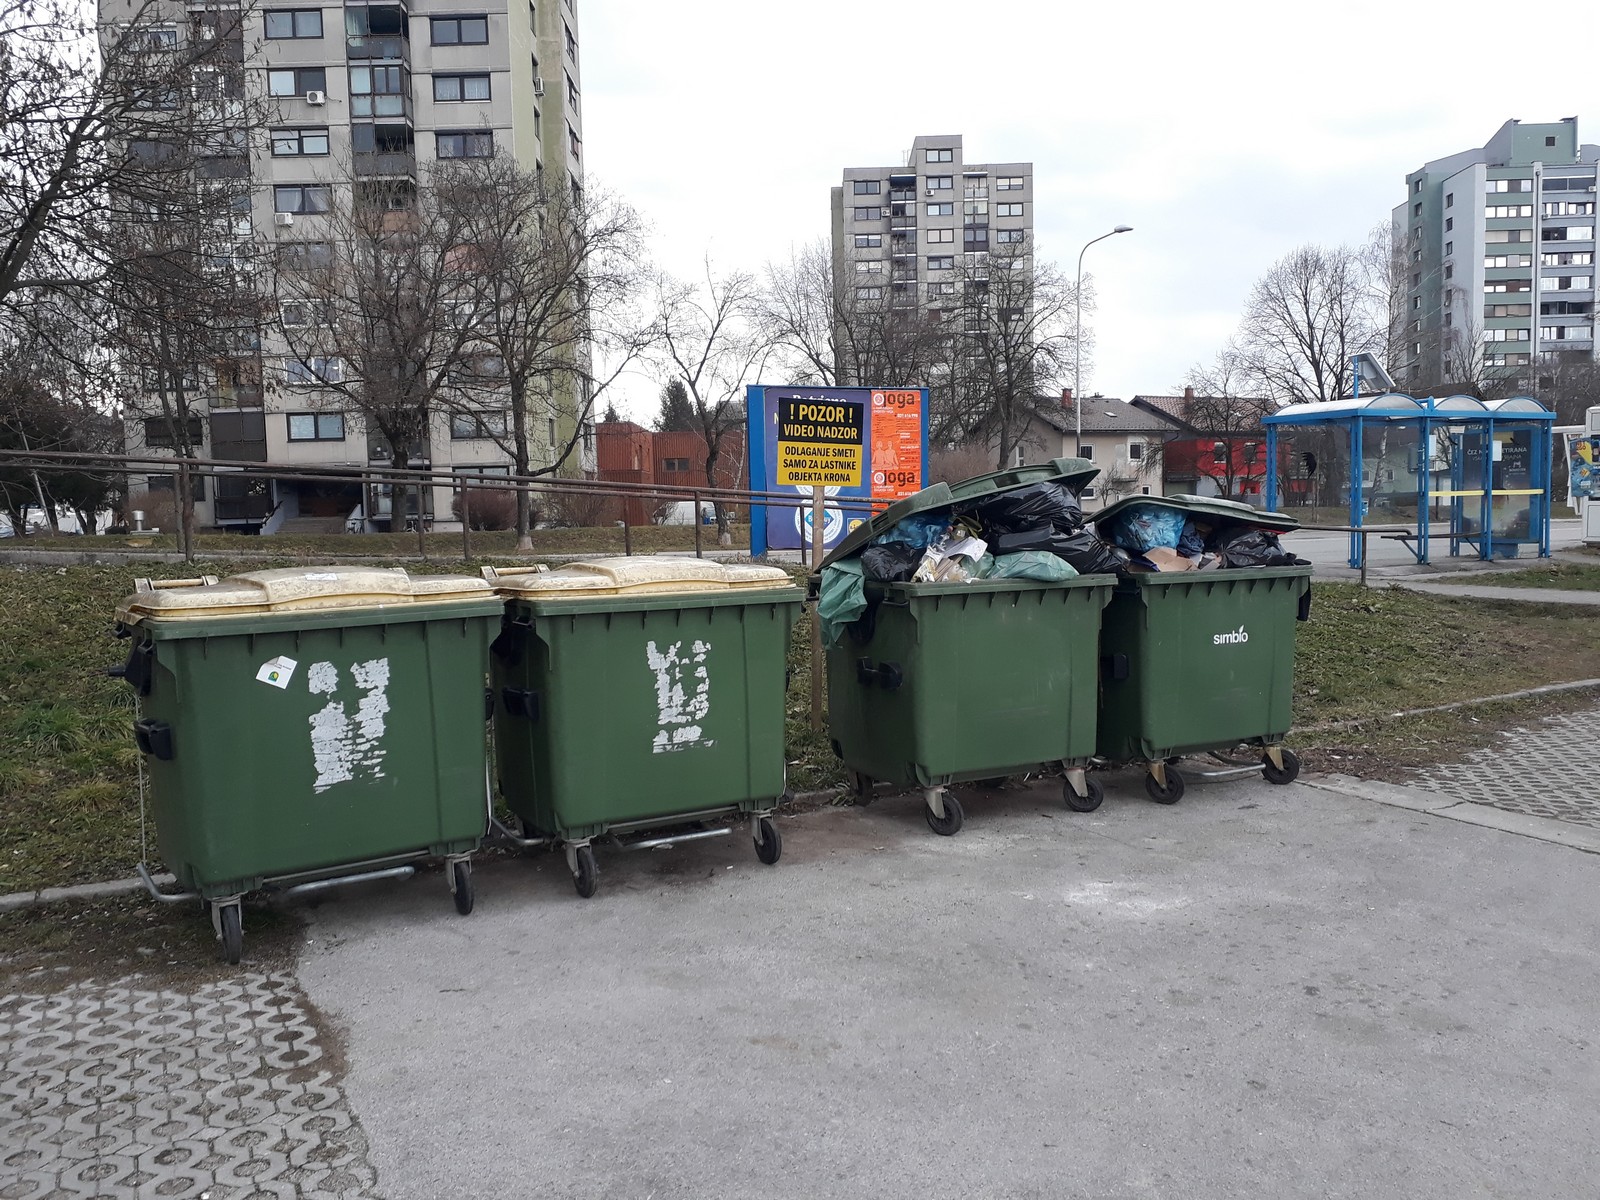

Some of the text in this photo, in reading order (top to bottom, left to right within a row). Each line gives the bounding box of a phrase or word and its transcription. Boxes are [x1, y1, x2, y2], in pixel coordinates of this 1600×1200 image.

[884, 391, 915, 409] joga
[790, 404, 795, 420] !
[799, 404, 845, 423] POZOR
[848, 407, 853, 423] !
[783, 423, 815, 437] VIDEO
[817, 425, 858, 439] NADZOR
[785, 446, 856, 458] ODLAGANJE SMETI
[783, 459, 857, 470] SAMO ZA LASTNIKE
[788, 472, 851, 483] OBJEKTA KRONA
[884, 470, 915, 487] joga
[1213, 625, 1249, 645] simbio
